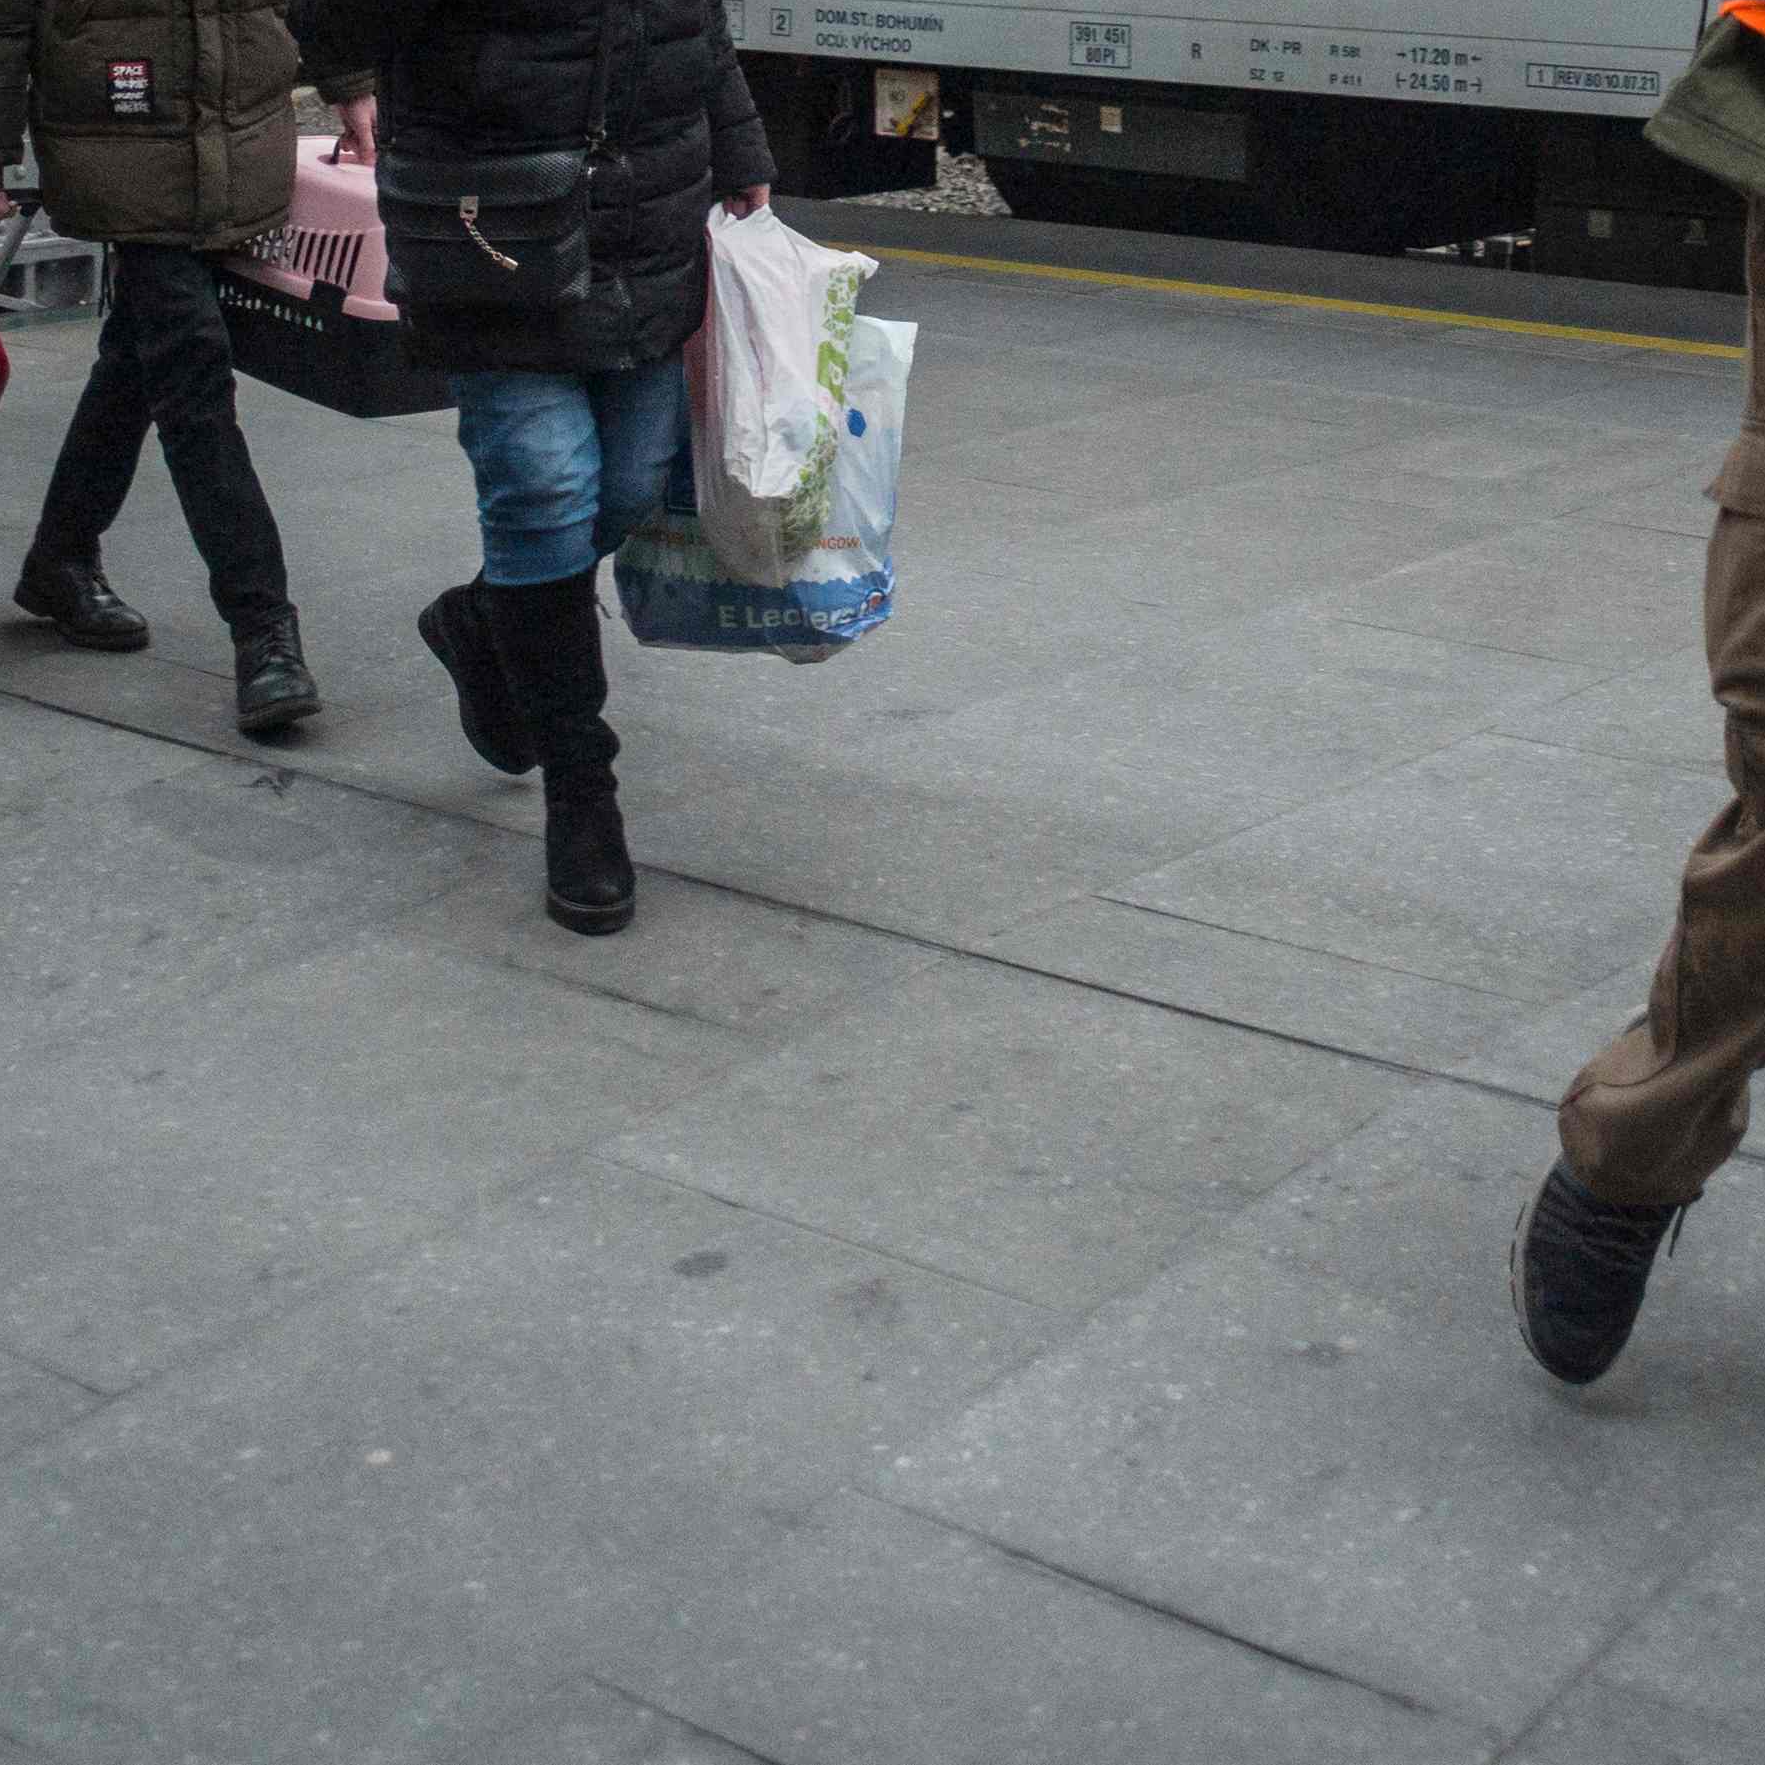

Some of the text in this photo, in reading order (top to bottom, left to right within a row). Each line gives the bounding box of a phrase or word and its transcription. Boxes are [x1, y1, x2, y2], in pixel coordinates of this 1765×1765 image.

[776, 14, 787, 31] 2
[1191, 42, 1203, 59] R
[1411, 47, 1469, 66] 17.20 m
[1409, 73, 1469, 93] 24.50 m
